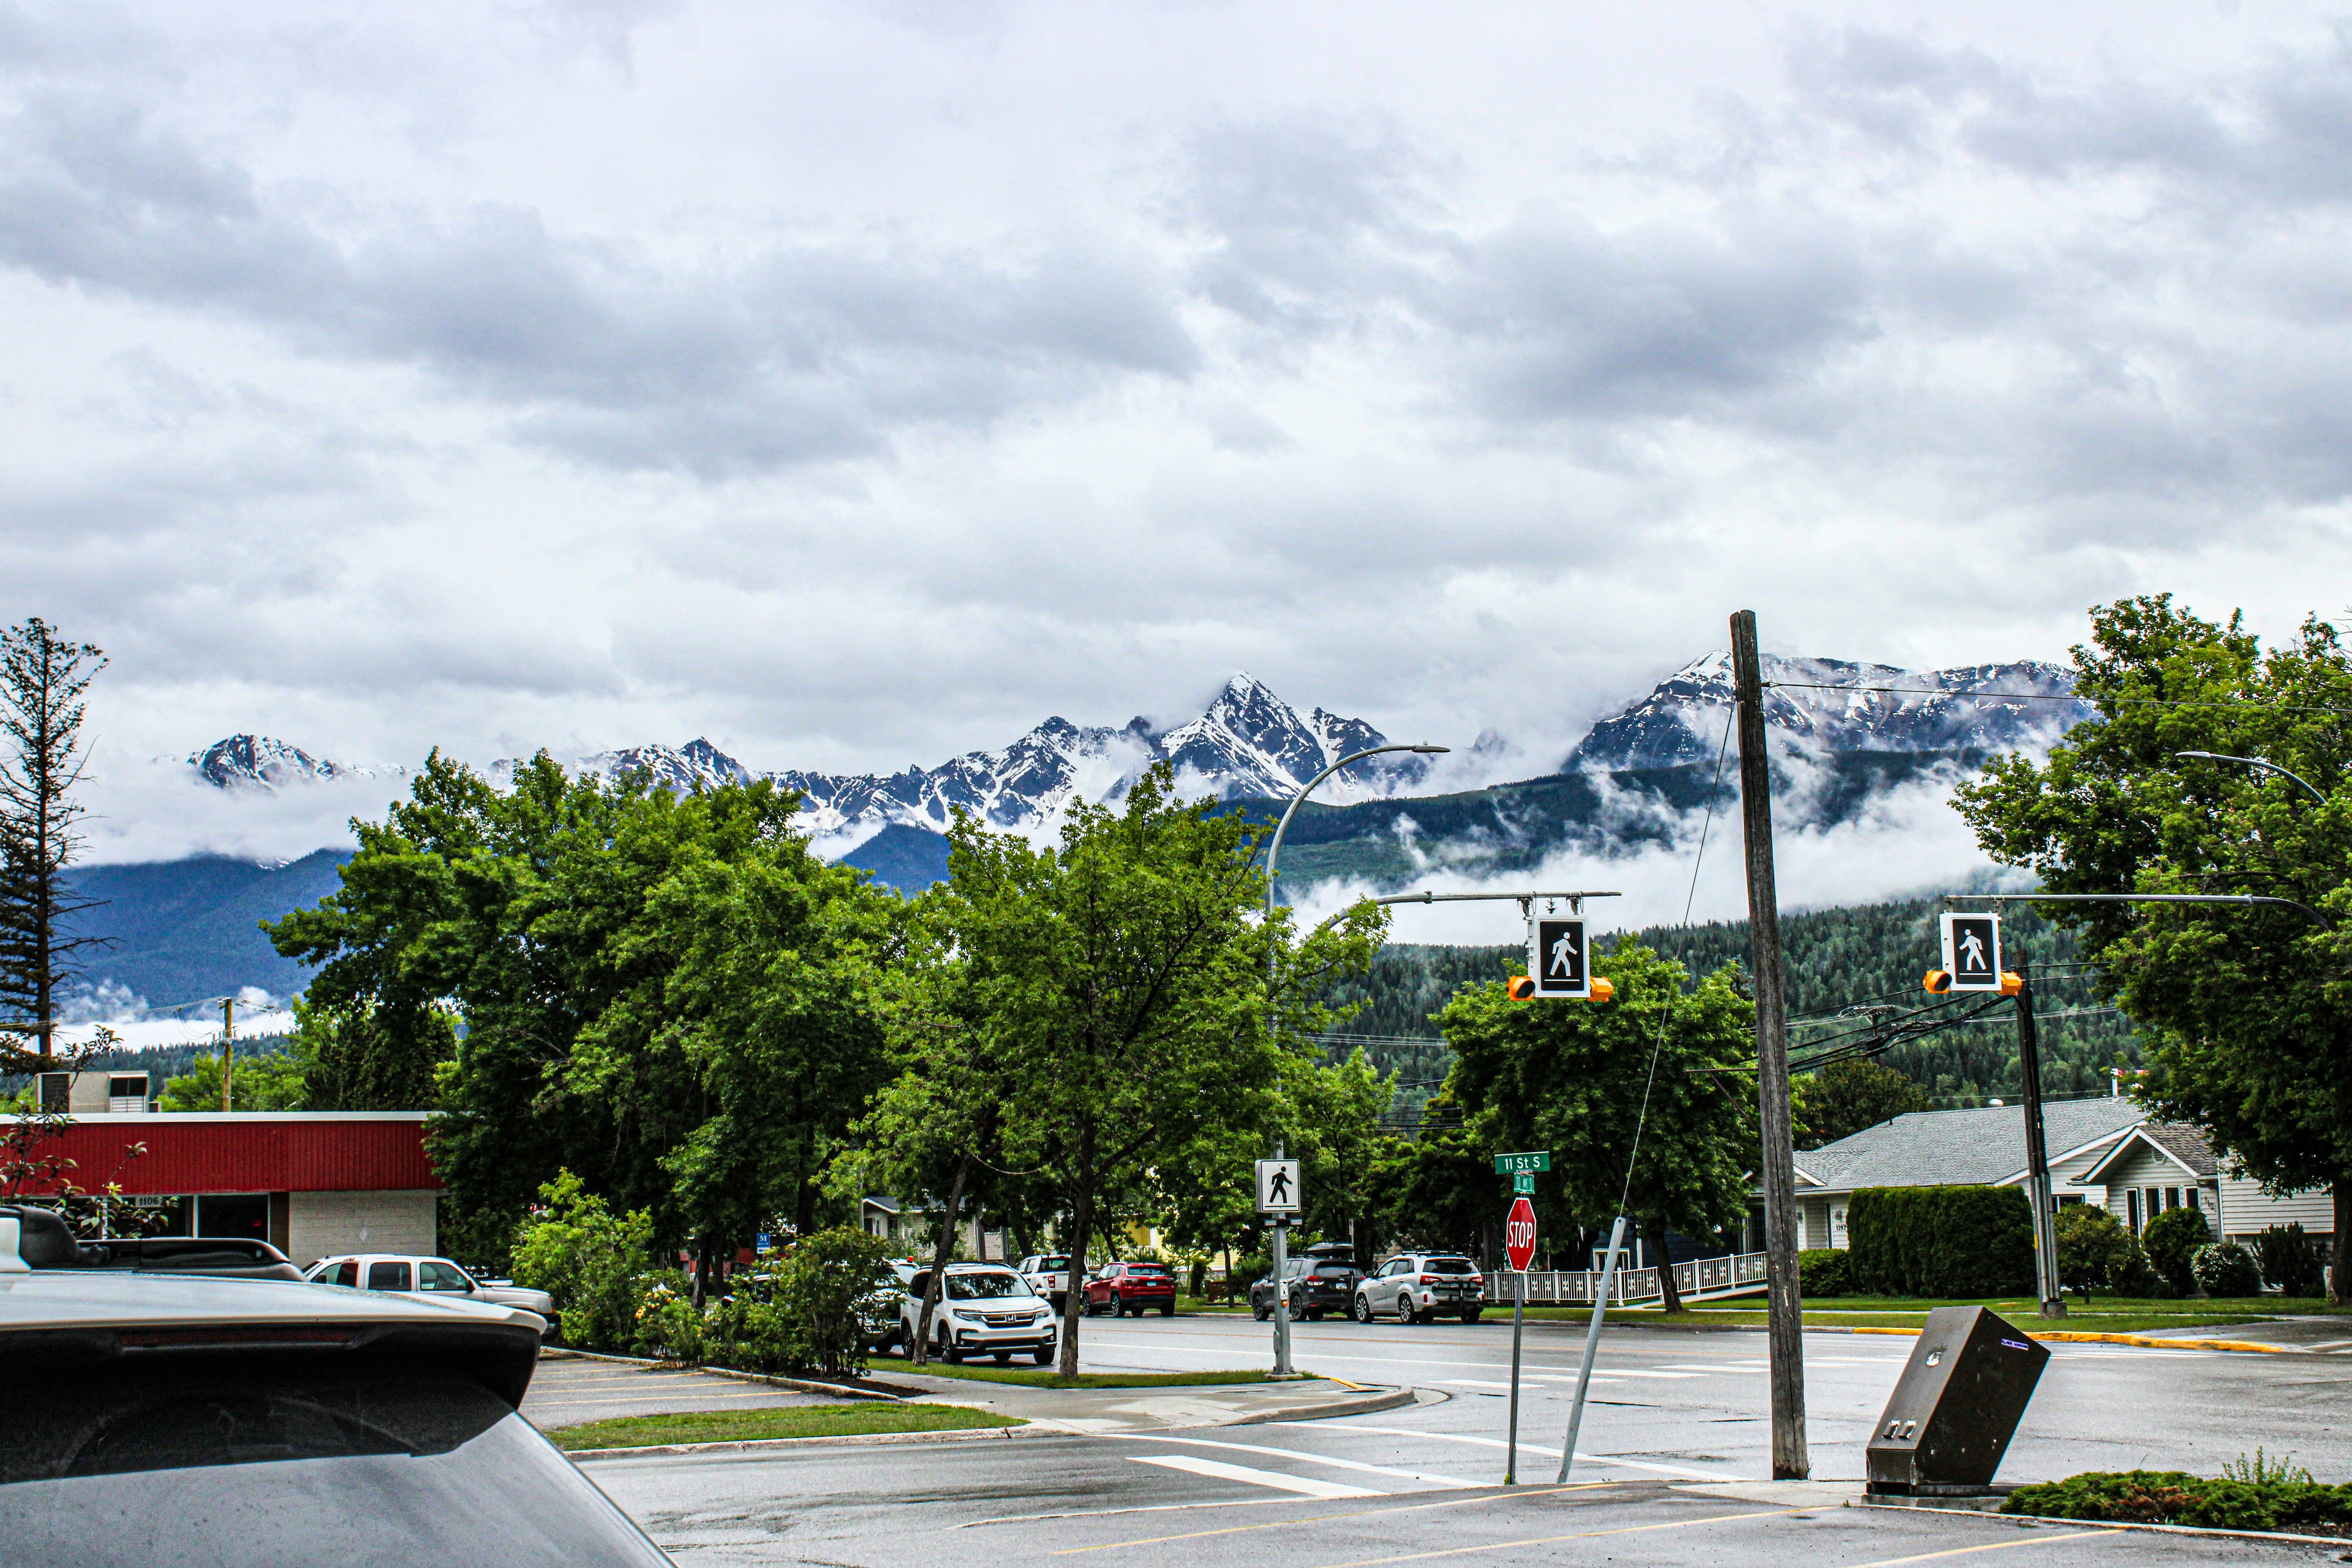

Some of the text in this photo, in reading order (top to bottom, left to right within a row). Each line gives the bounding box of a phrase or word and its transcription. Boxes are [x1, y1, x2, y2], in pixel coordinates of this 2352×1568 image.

[1504, 1156, 1540, 1170] 11 St S
[139, 1197, 159, 1205] 1106
[1508, 1221, 1533, 1249] STOP
